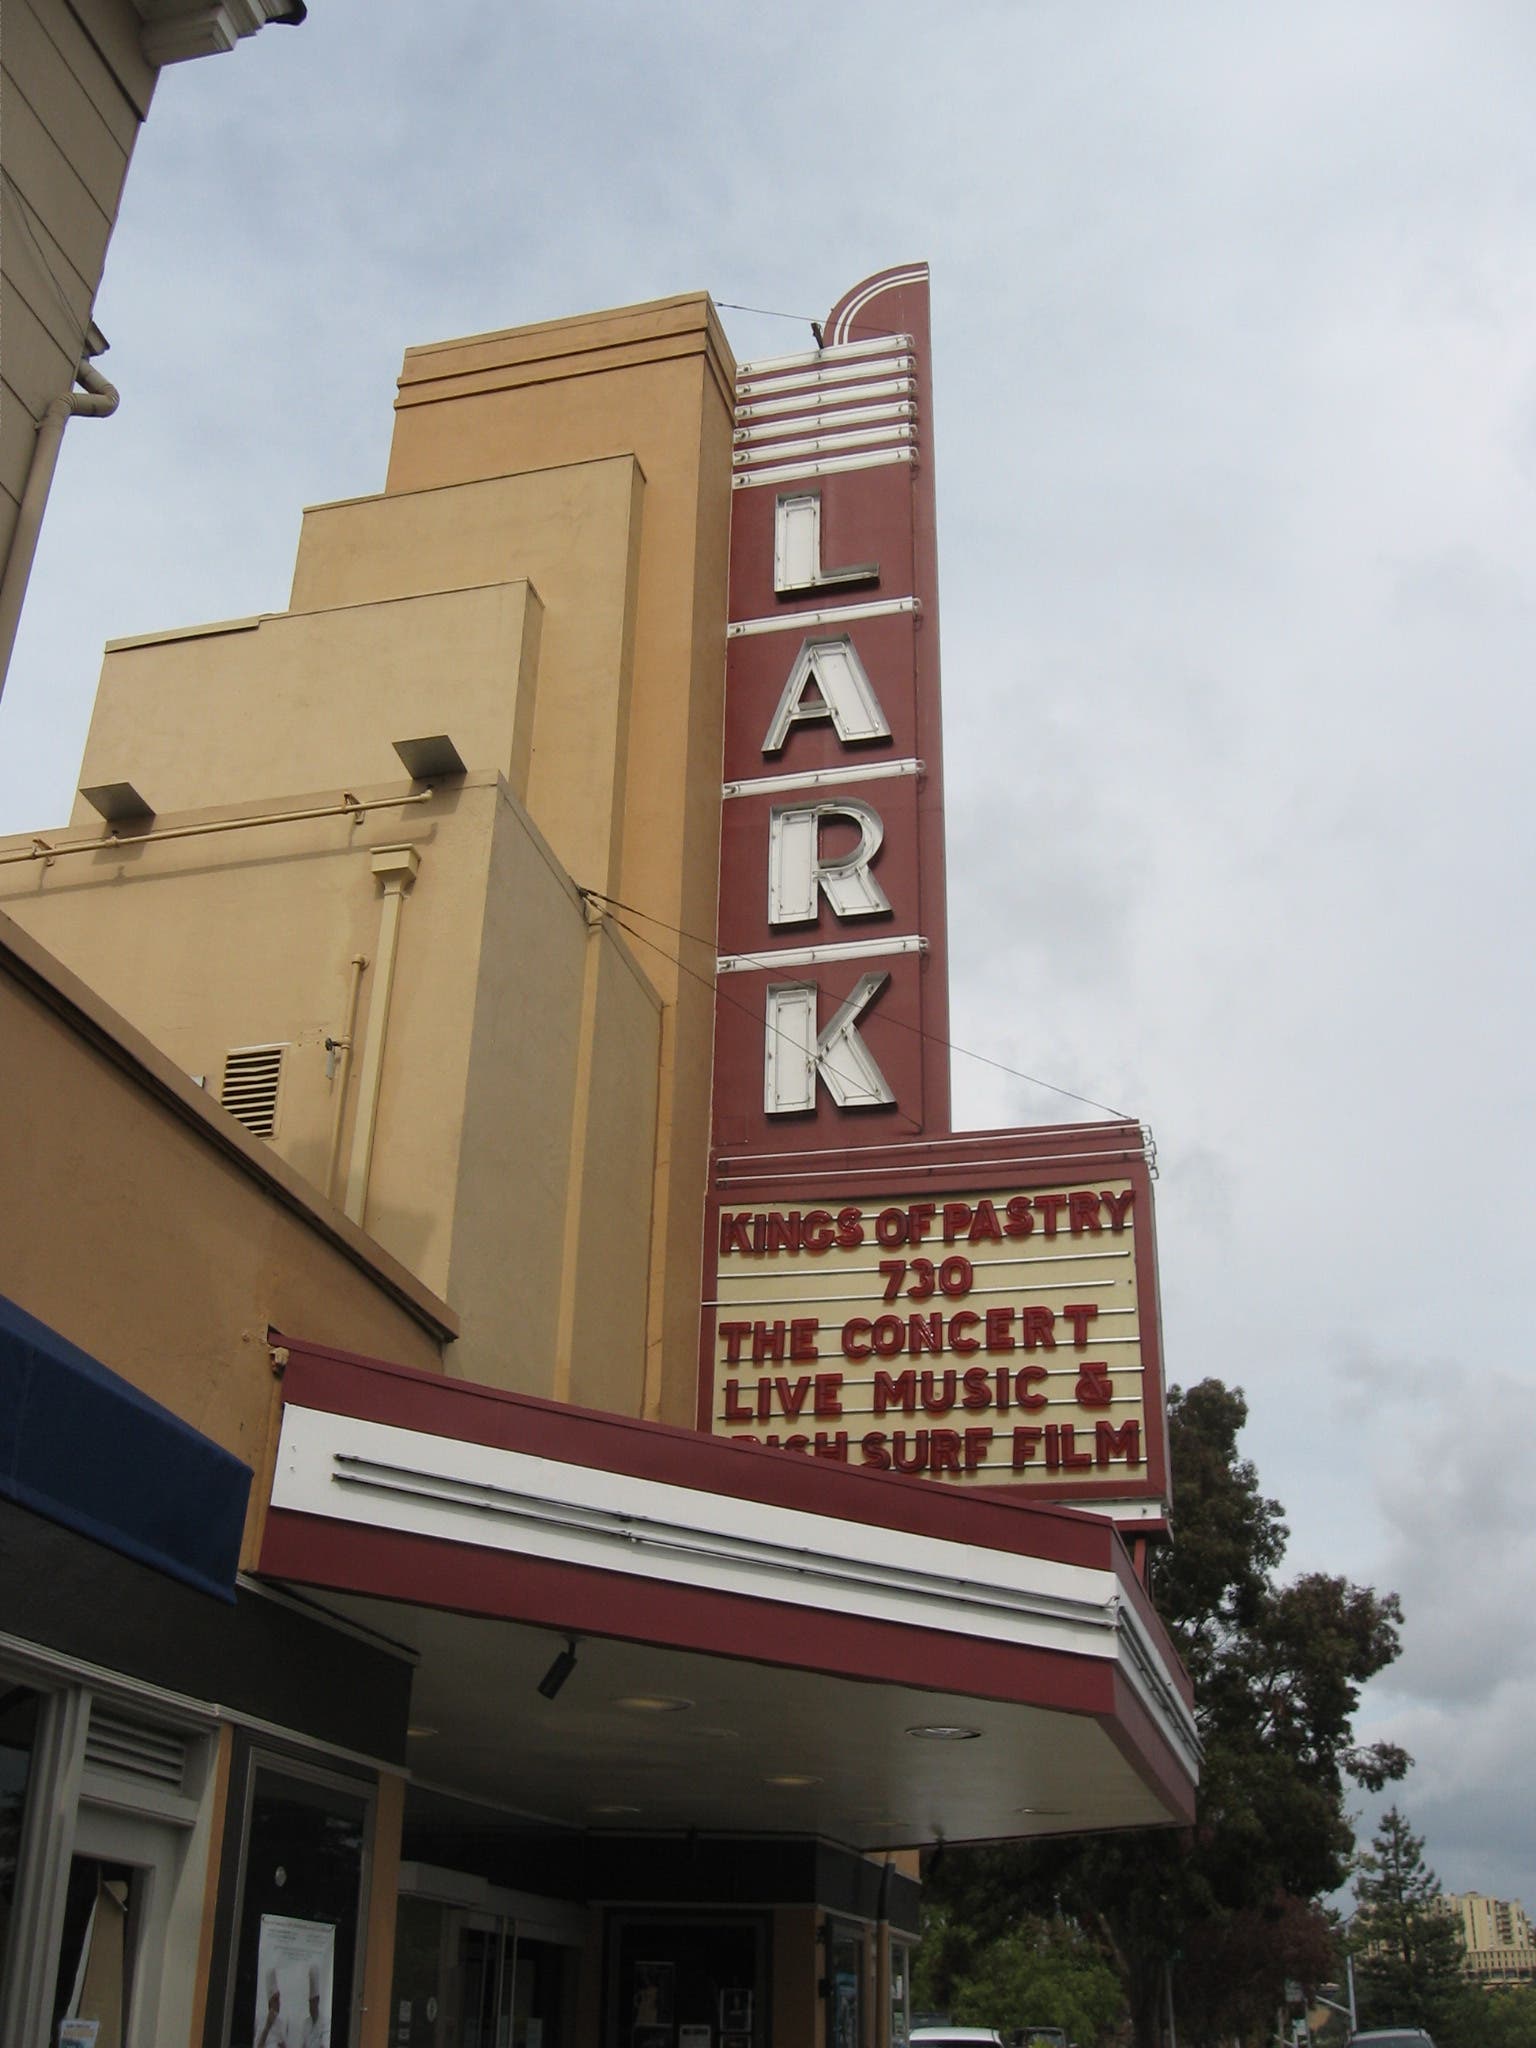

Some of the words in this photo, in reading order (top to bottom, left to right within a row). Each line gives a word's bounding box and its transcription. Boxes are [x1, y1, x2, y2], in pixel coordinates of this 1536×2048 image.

[761, 488, 897, 1115] LARK
[720, 1207, 864, 1253] KINGS
[875, 1204, 935, 1246] OF
[943, 1190, 1135, 1243] PASTRY
[879, 1255, 973, 1300] 730
[719, 1318, 819, 1363] THE
[841, 1304, 1098, 1358] CONCERT
[725, 1373, 843, 1420] LIVE
[874, 1365, 1049, 1413] MUSIC
[1075, 1361, 1113, 1407] &
[861, 1427, 993, 1473] SURF
[1013, 1419, 1140, 1469] FILM
